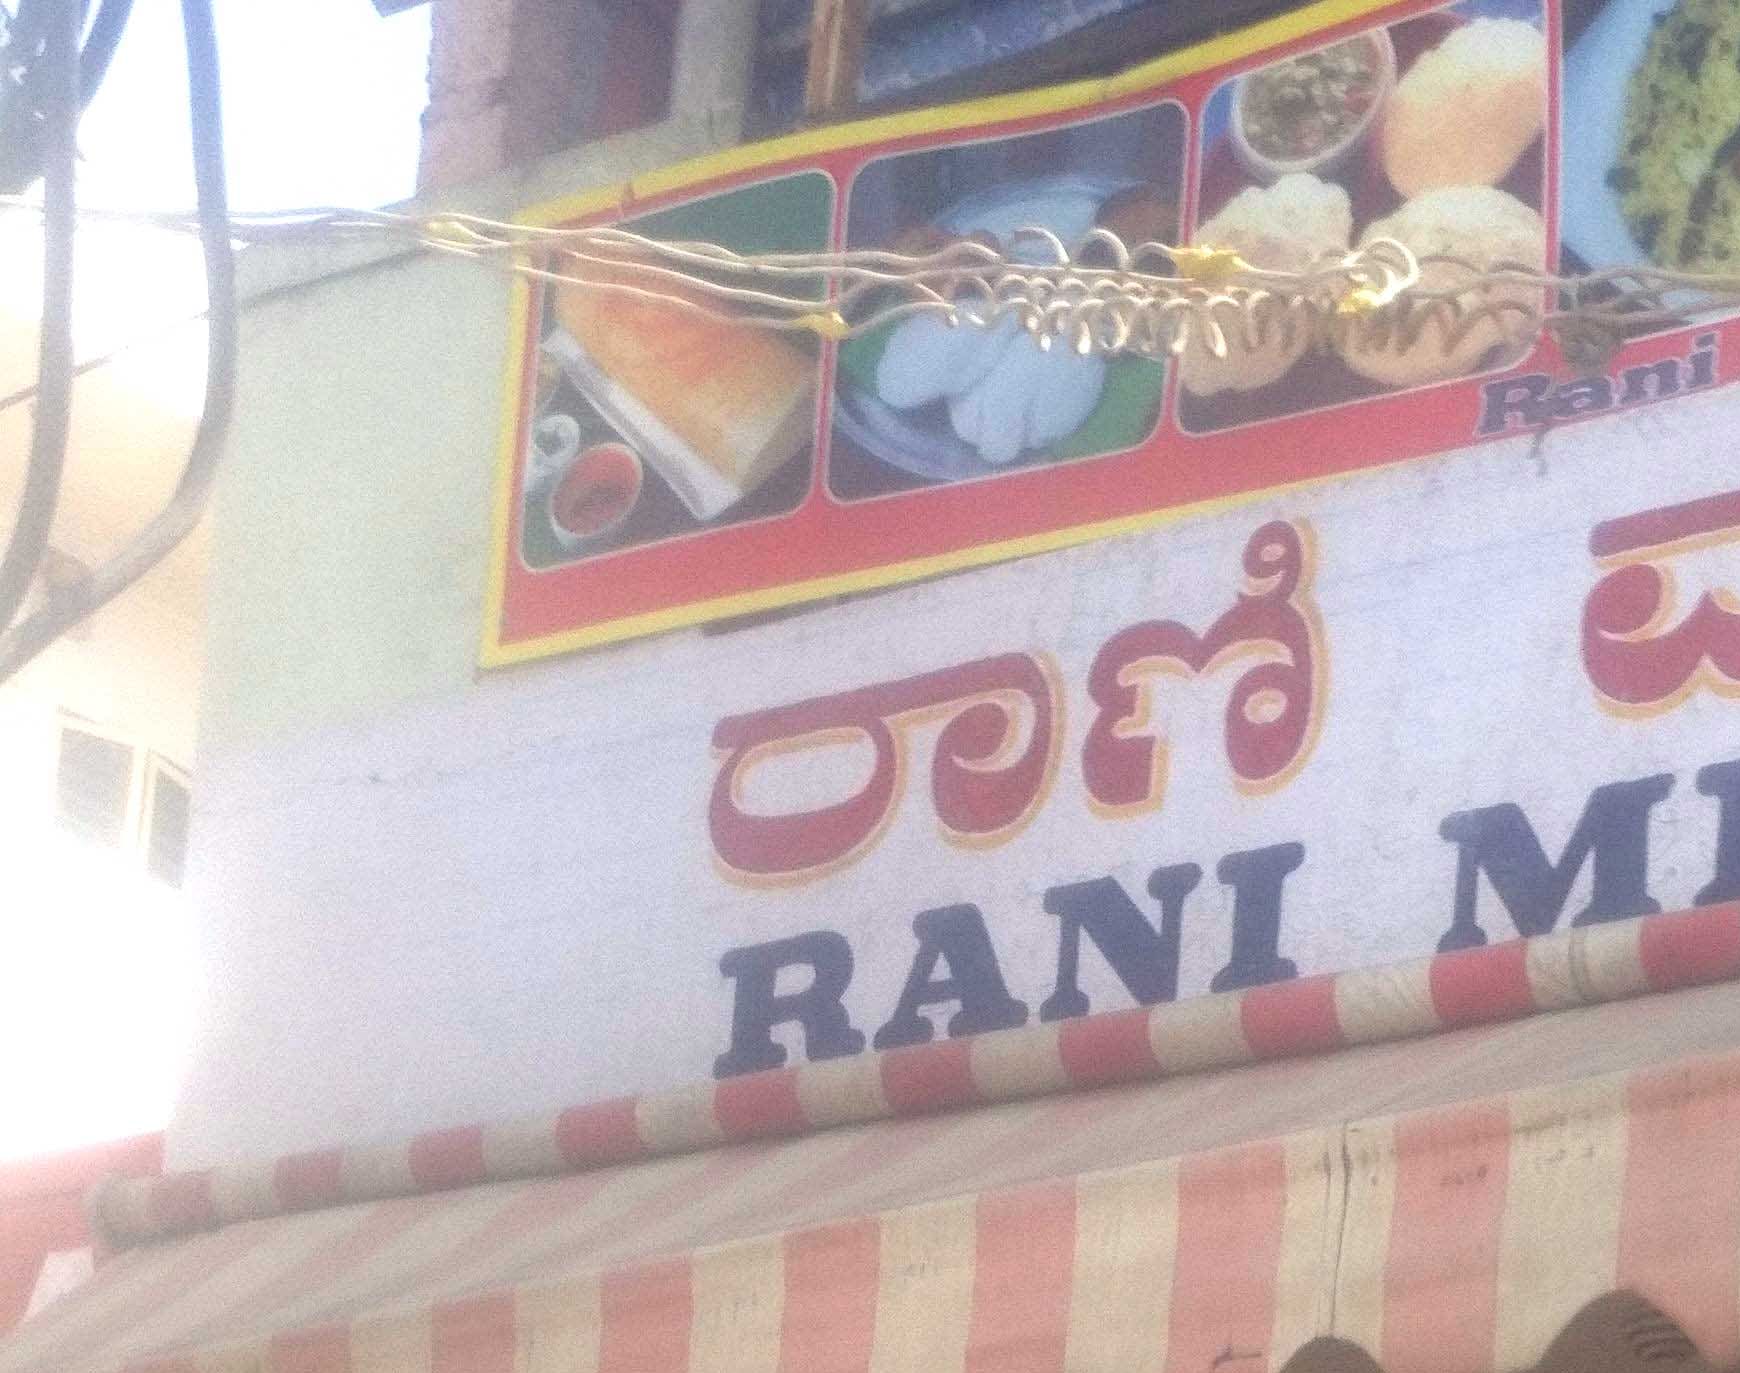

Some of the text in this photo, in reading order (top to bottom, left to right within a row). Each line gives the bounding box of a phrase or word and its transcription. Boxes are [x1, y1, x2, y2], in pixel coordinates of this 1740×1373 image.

[1476, 331, 1722, 438] Rani
[708, 515, 1334, 890] ರಾಣಿ
[713, 840, 1306, 1079] RANI
